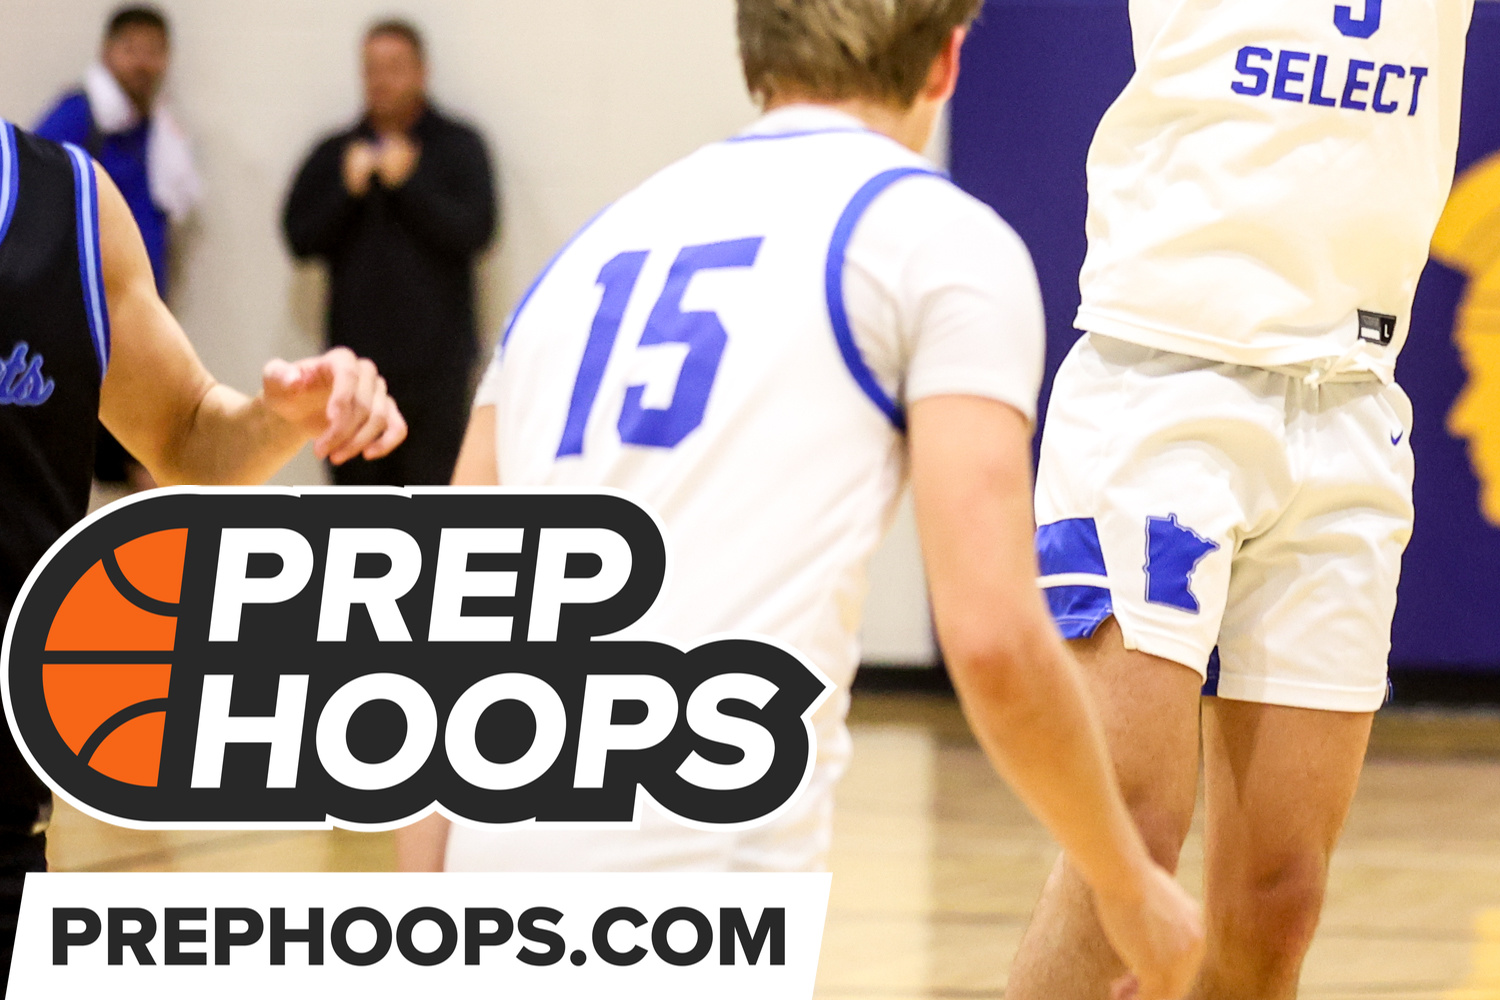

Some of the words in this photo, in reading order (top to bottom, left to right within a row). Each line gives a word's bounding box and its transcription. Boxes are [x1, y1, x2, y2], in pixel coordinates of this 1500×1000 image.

[1230, 45, 1429, 117] SELECT
[0, 341, 55, 407] ts
[555, 235, 765, 461] 15
